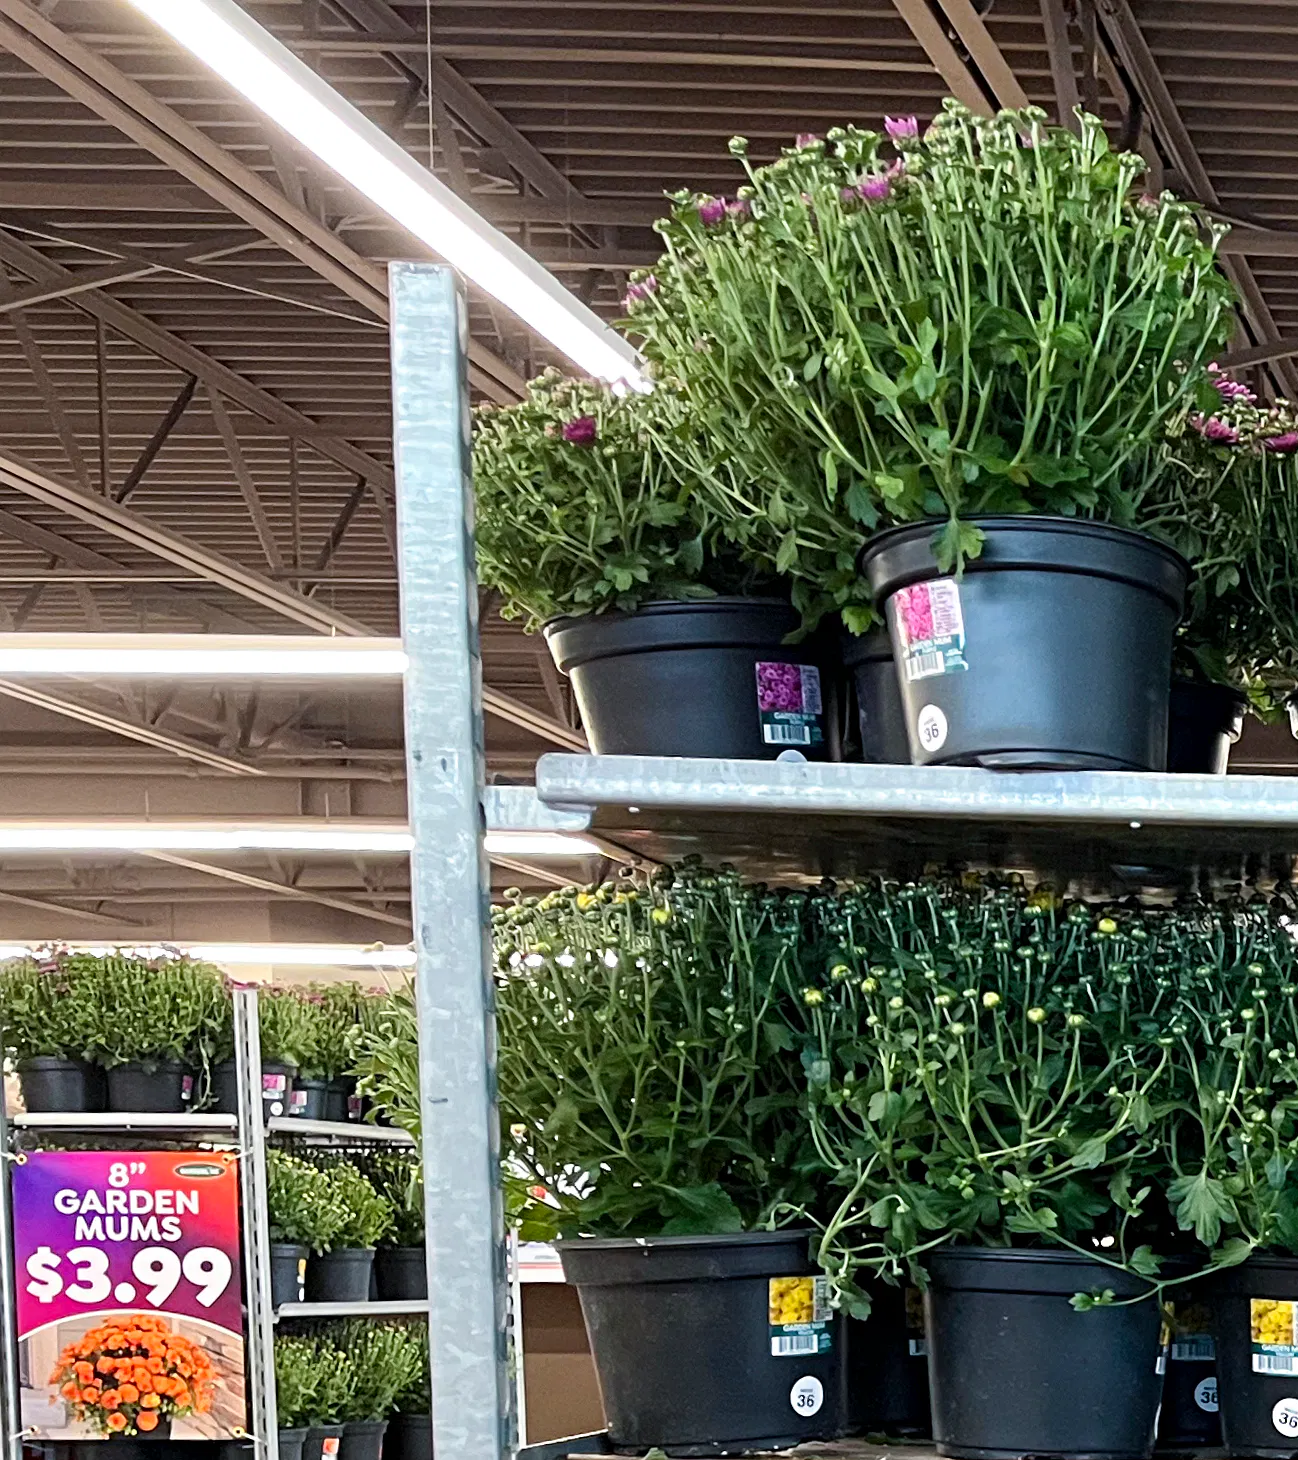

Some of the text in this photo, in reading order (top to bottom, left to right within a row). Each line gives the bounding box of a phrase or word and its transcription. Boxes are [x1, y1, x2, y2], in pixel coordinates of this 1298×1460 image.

[54, 1188, 200, 1215] GARDEN
[75, 1215, 182, 1241] MUMS
[25, 1246, 232, 1308] $3.99
[797, 1394, 815, 1408] 36
